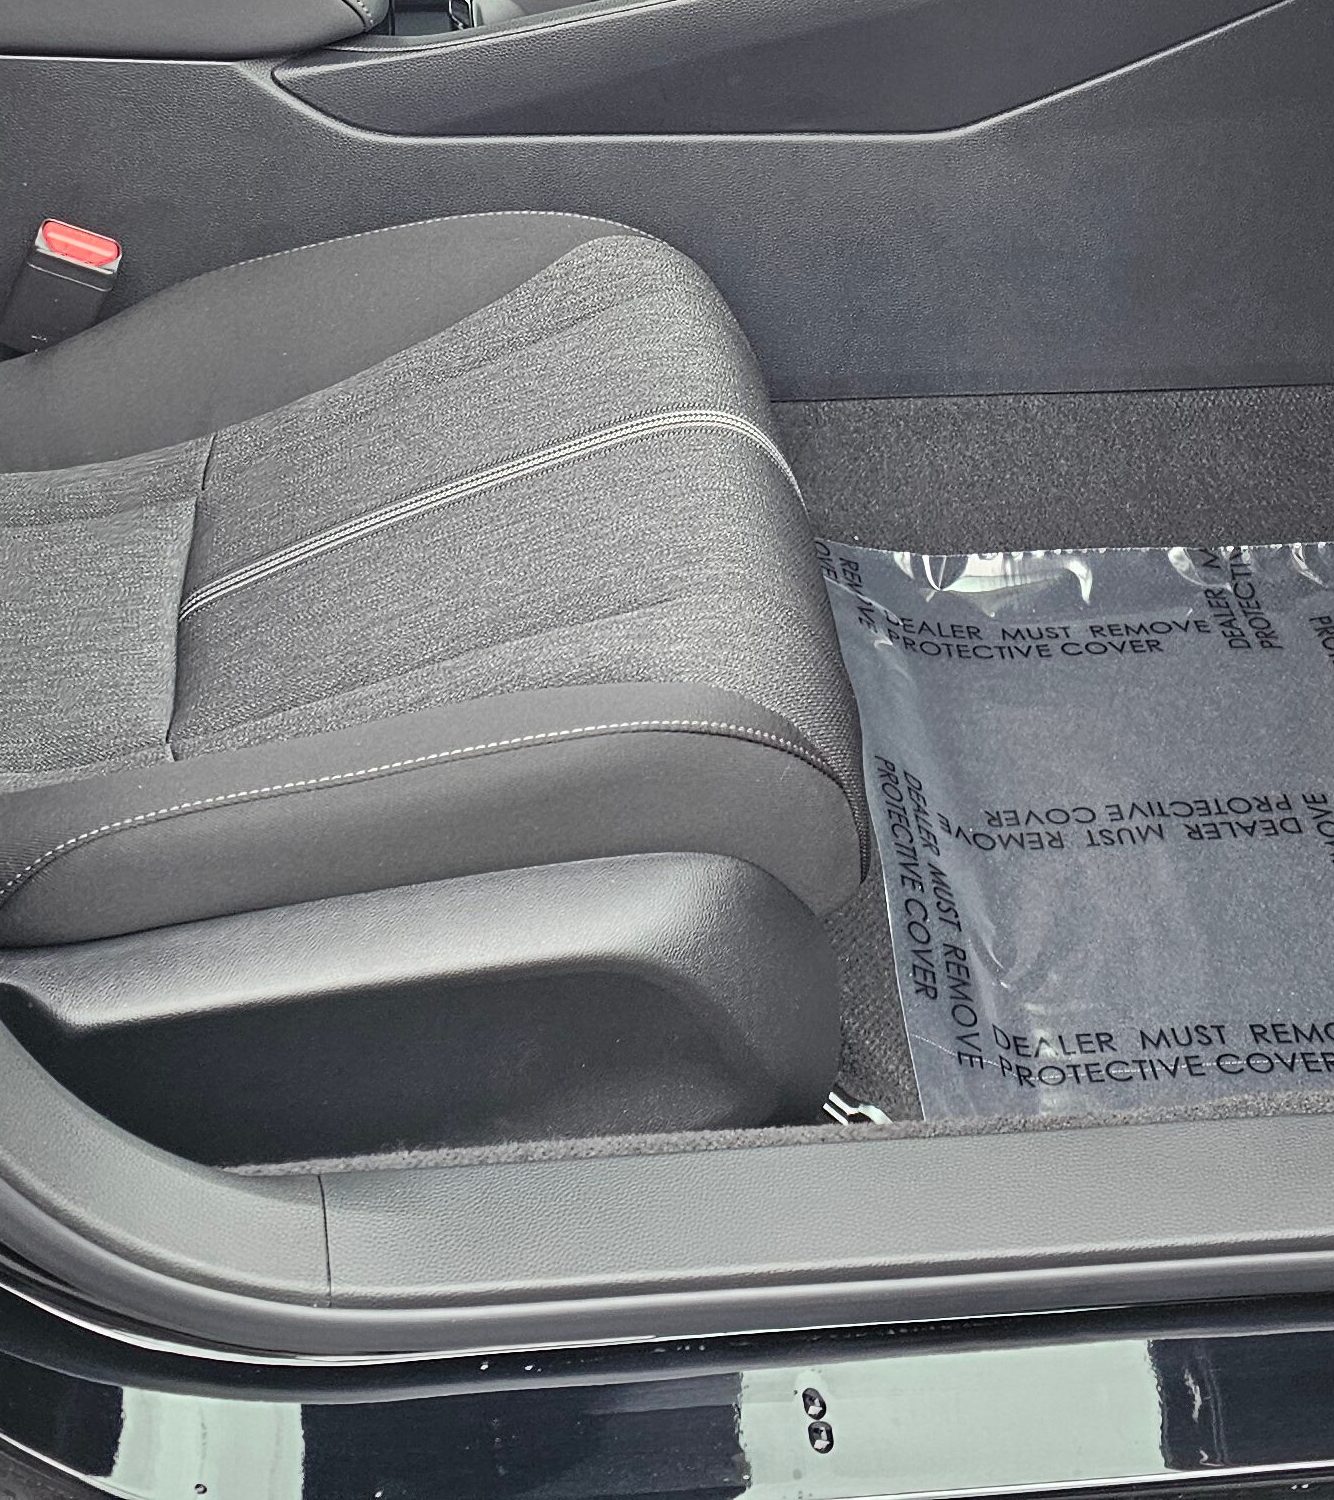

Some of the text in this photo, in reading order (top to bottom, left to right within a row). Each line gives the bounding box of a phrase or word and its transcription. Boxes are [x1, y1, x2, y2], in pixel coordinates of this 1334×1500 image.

[884, 610, 1212, 642] DEALER MUST REMOVE
[1204, 587, 1252, 650] DEALER
[887, 629, 1164, 660] PROTECTIVE COVER
[983, 793, 1292, 828] PROTECTIVE COVER
[936, 811, 1304, 851] DEALER MUST REMOVE
[874, 754, 937, 1001] PROTECTIVE COVER
[903, 769, 984, 1070] DEALER MUST REMOVE
[992, 1023, 1118, 1059] DEALER
[1140, 1024, 1226, 1051] MUST
[1000, 1054, 1205, 1087] PROTECTIVE
